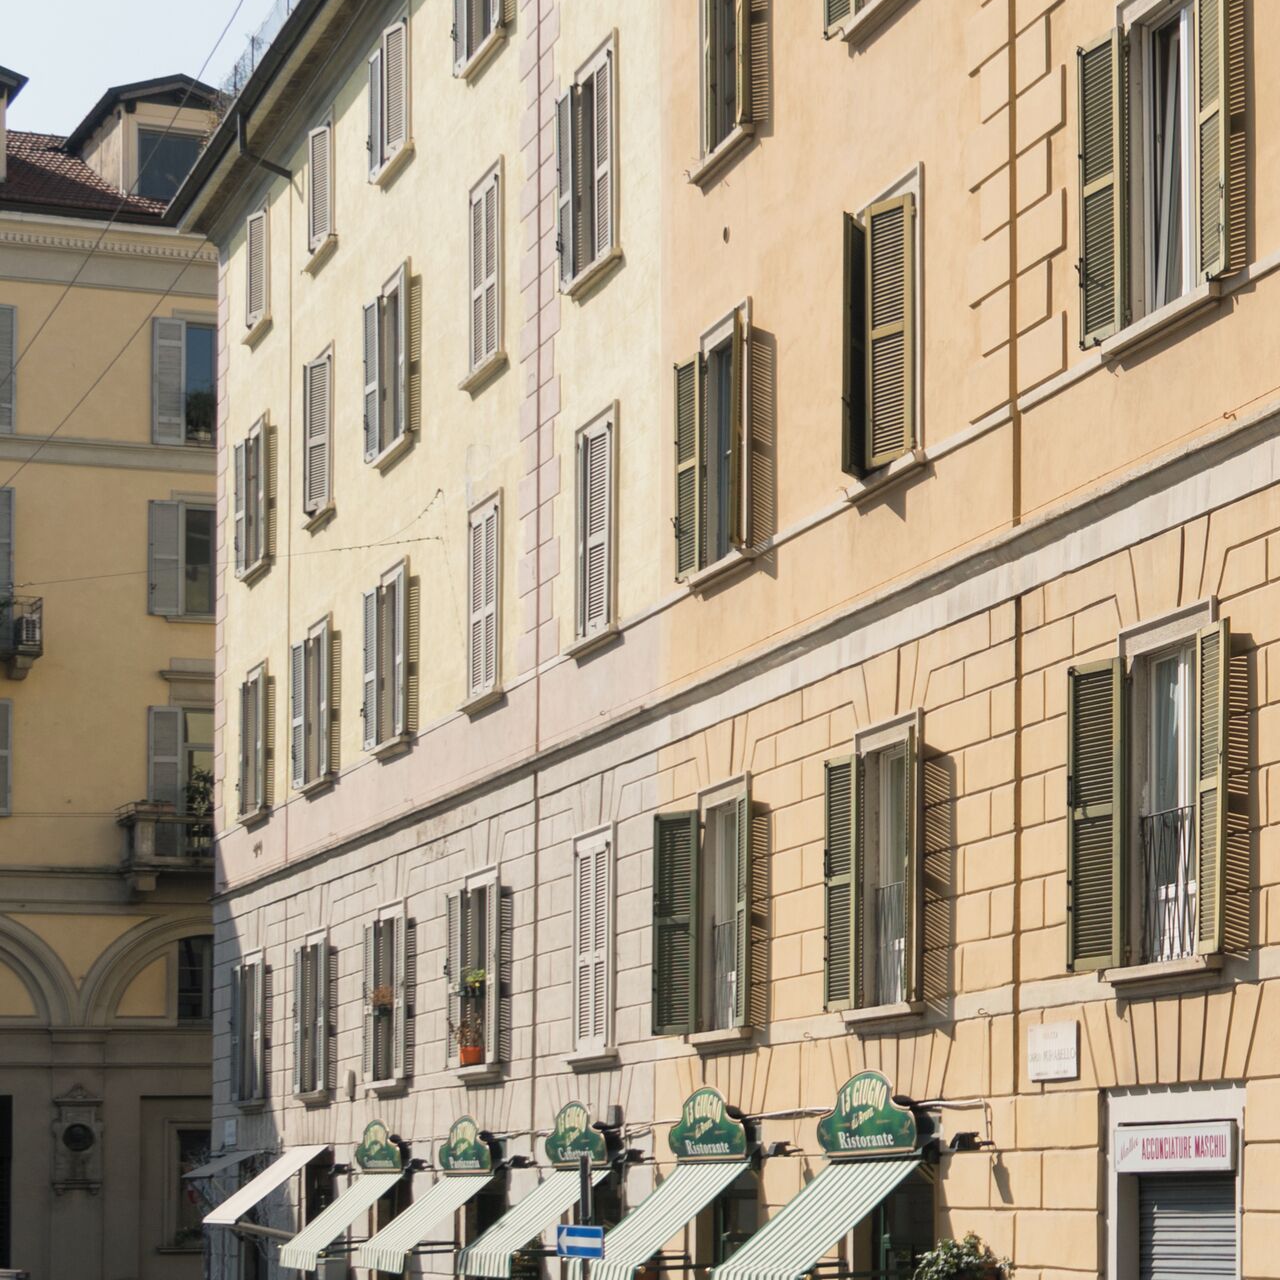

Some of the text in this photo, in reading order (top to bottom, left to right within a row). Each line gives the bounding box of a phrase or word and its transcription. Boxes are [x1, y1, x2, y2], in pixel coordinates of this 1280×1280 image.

[686, 1094, 722, 1127] 13 GIUGNO
[841, 1078, 887, 1117] 13 GIUGNO
[685, 1139, 730, 1155] Ristorante
[838, 1131, 894, 1149] Ristorante
[1142, 1136, 1192, 1161] ACCONCIATURE
[1194, 1134, 1227, 1159] MASCHILI
